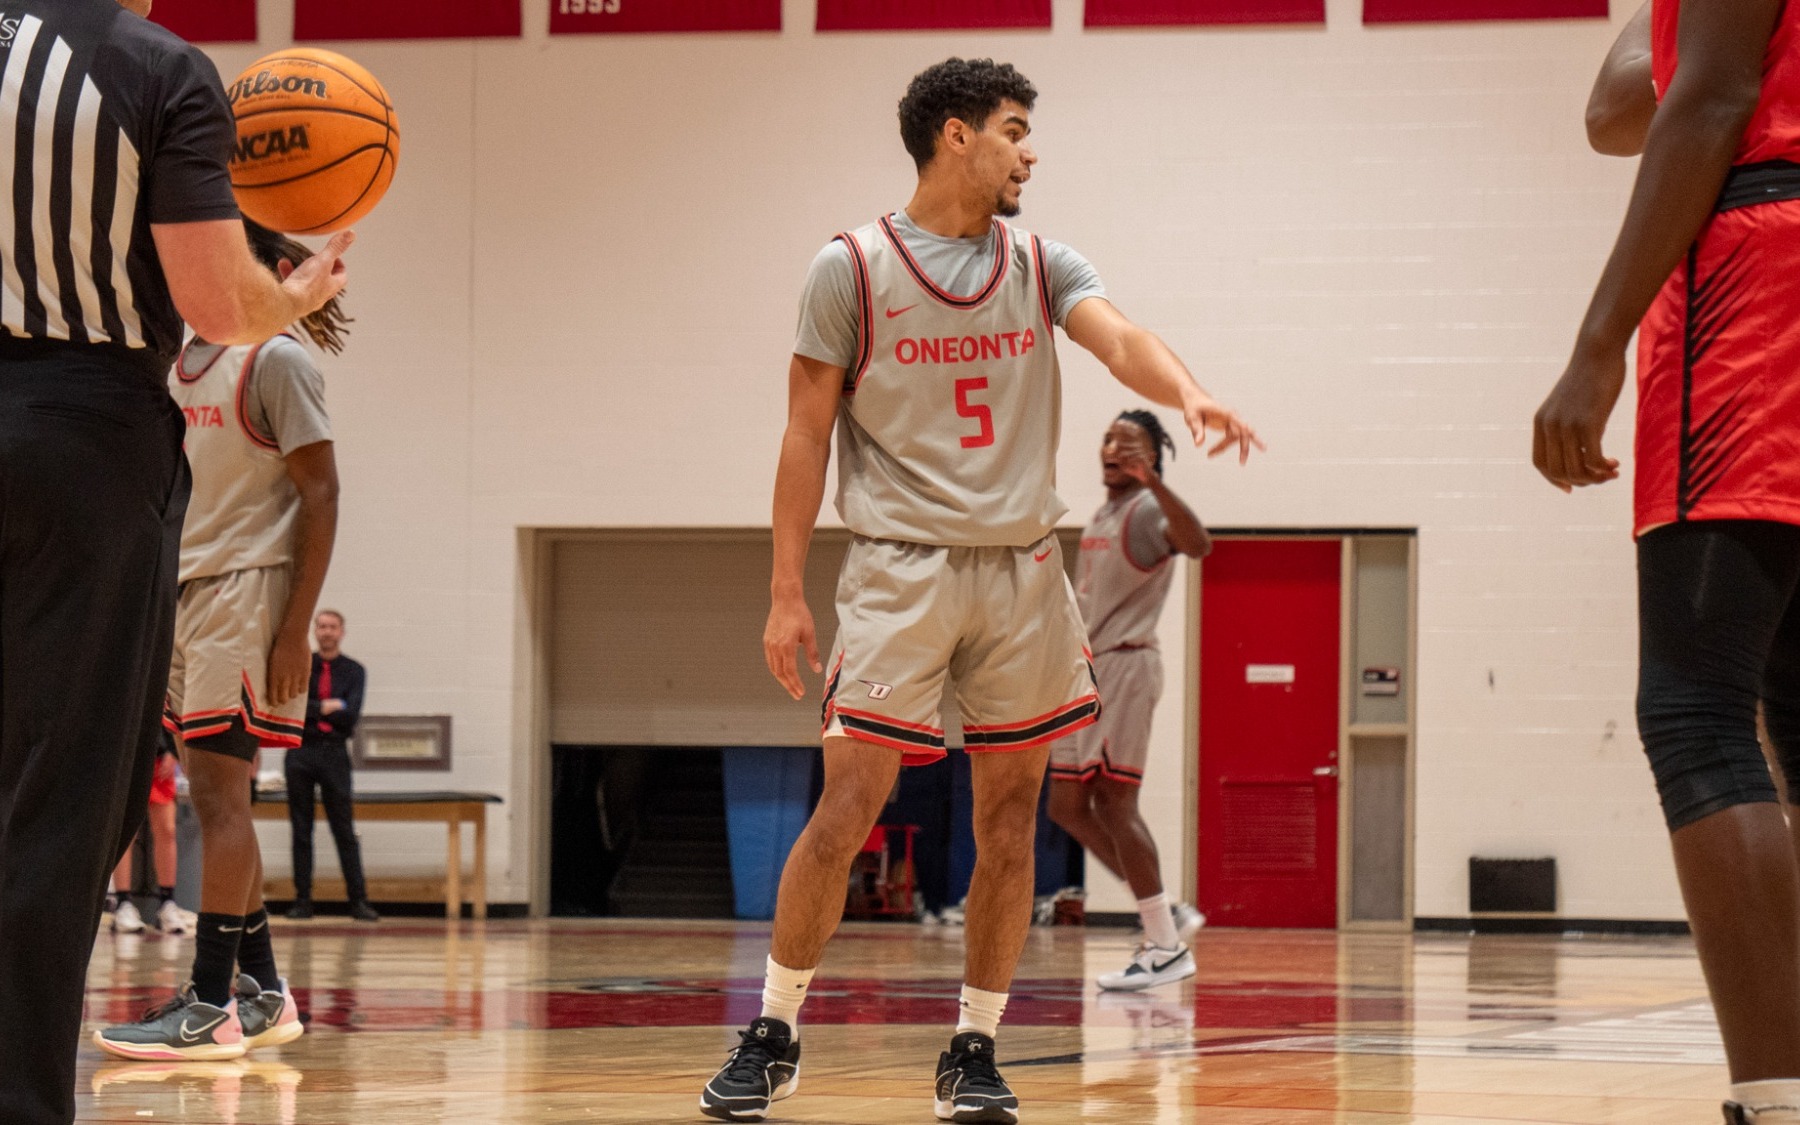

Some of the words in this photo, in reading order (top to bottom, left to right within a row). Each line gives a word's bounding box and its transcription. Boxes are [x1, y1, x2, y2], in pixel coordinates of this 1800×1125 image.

[230, 125, 309, 163] NCAA
[895, 328, 1035, 365] ONEONTA
[182, 405, 224, 428] NTA
[955, 377, 995, 449] 5
